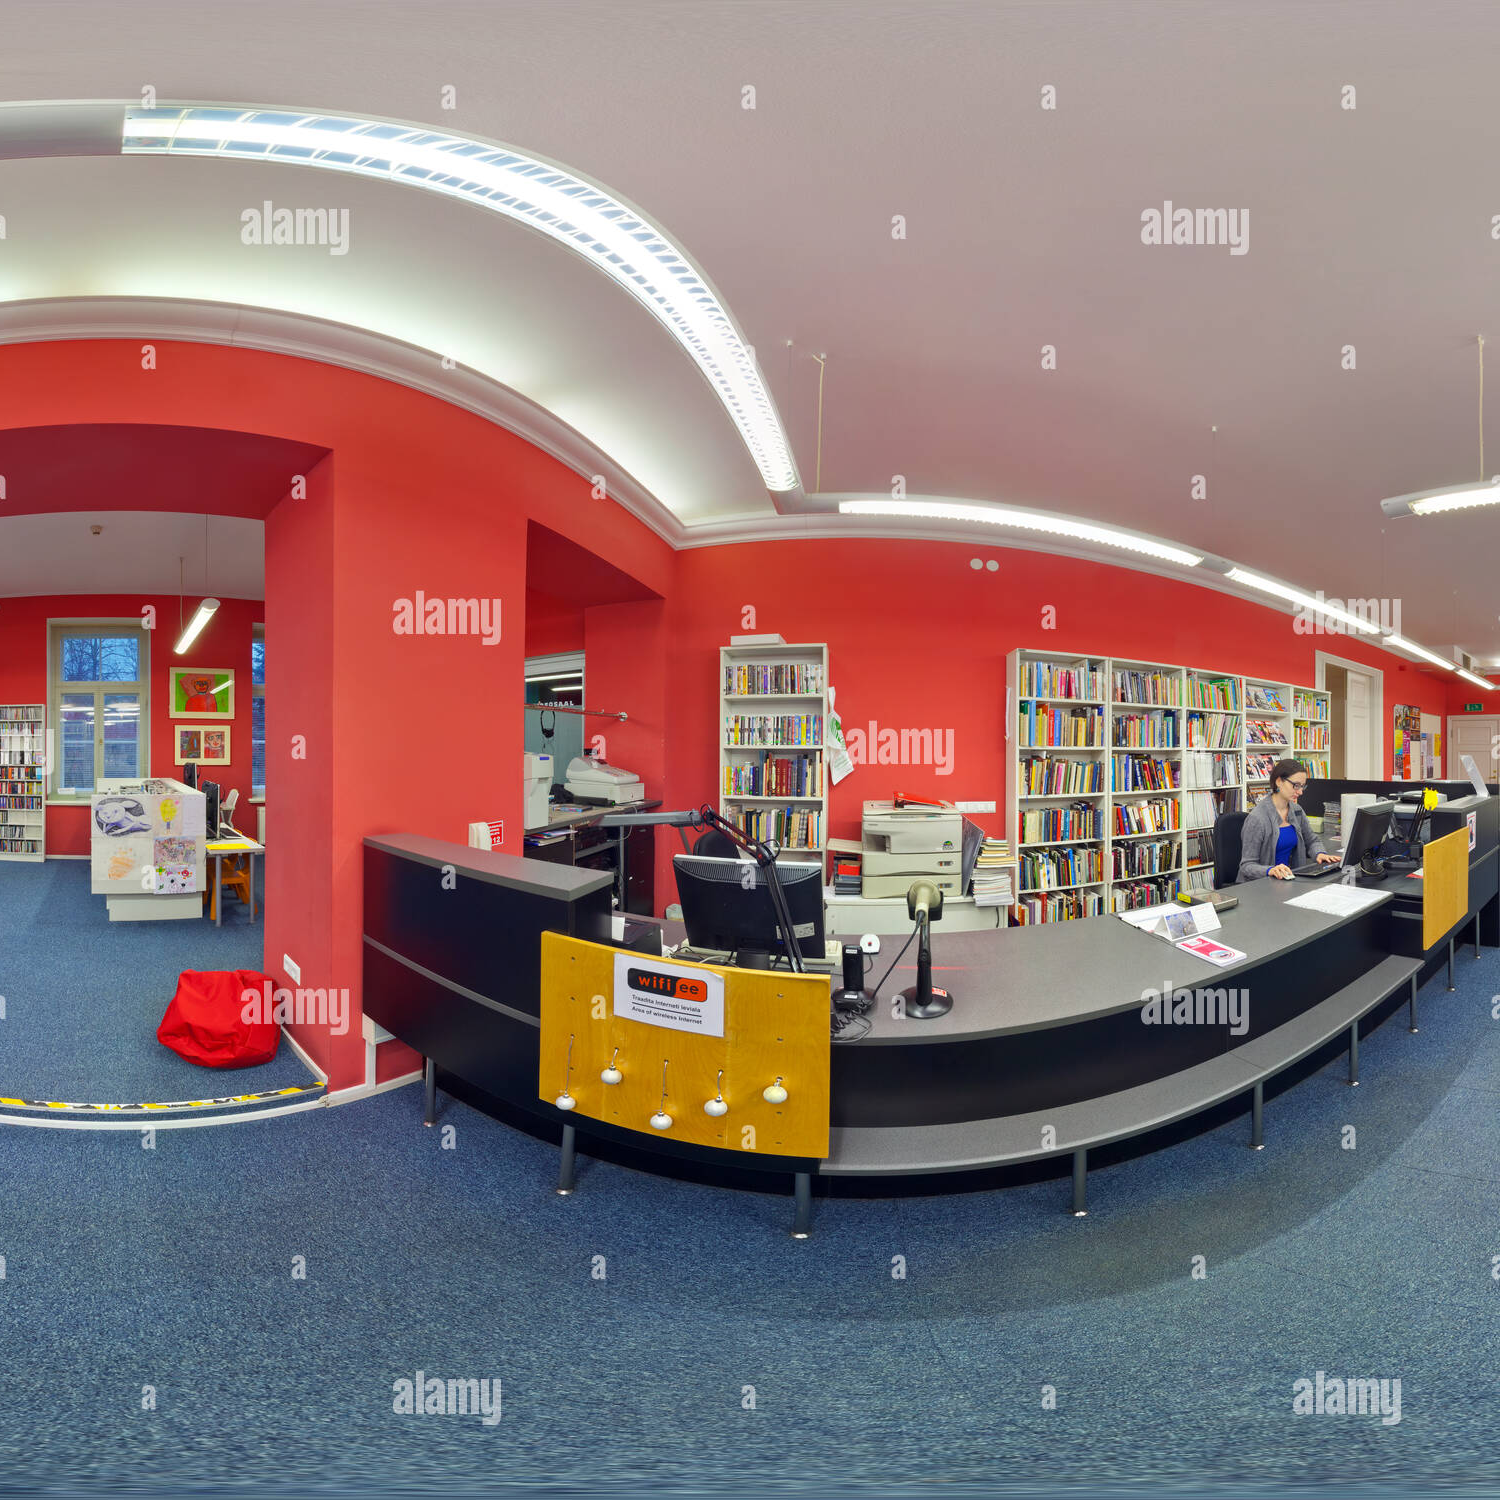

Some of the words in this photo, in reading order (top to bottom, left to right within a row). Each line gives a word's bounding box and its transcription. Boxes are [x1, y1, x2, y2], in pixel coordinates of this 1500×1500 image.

[638, 975, 671, 991] wifi
[632, 994, 654, 1003] Traadita
[681, 1005, 701, 1013] leviala
[653, 1011, 677, 1020] wireless
